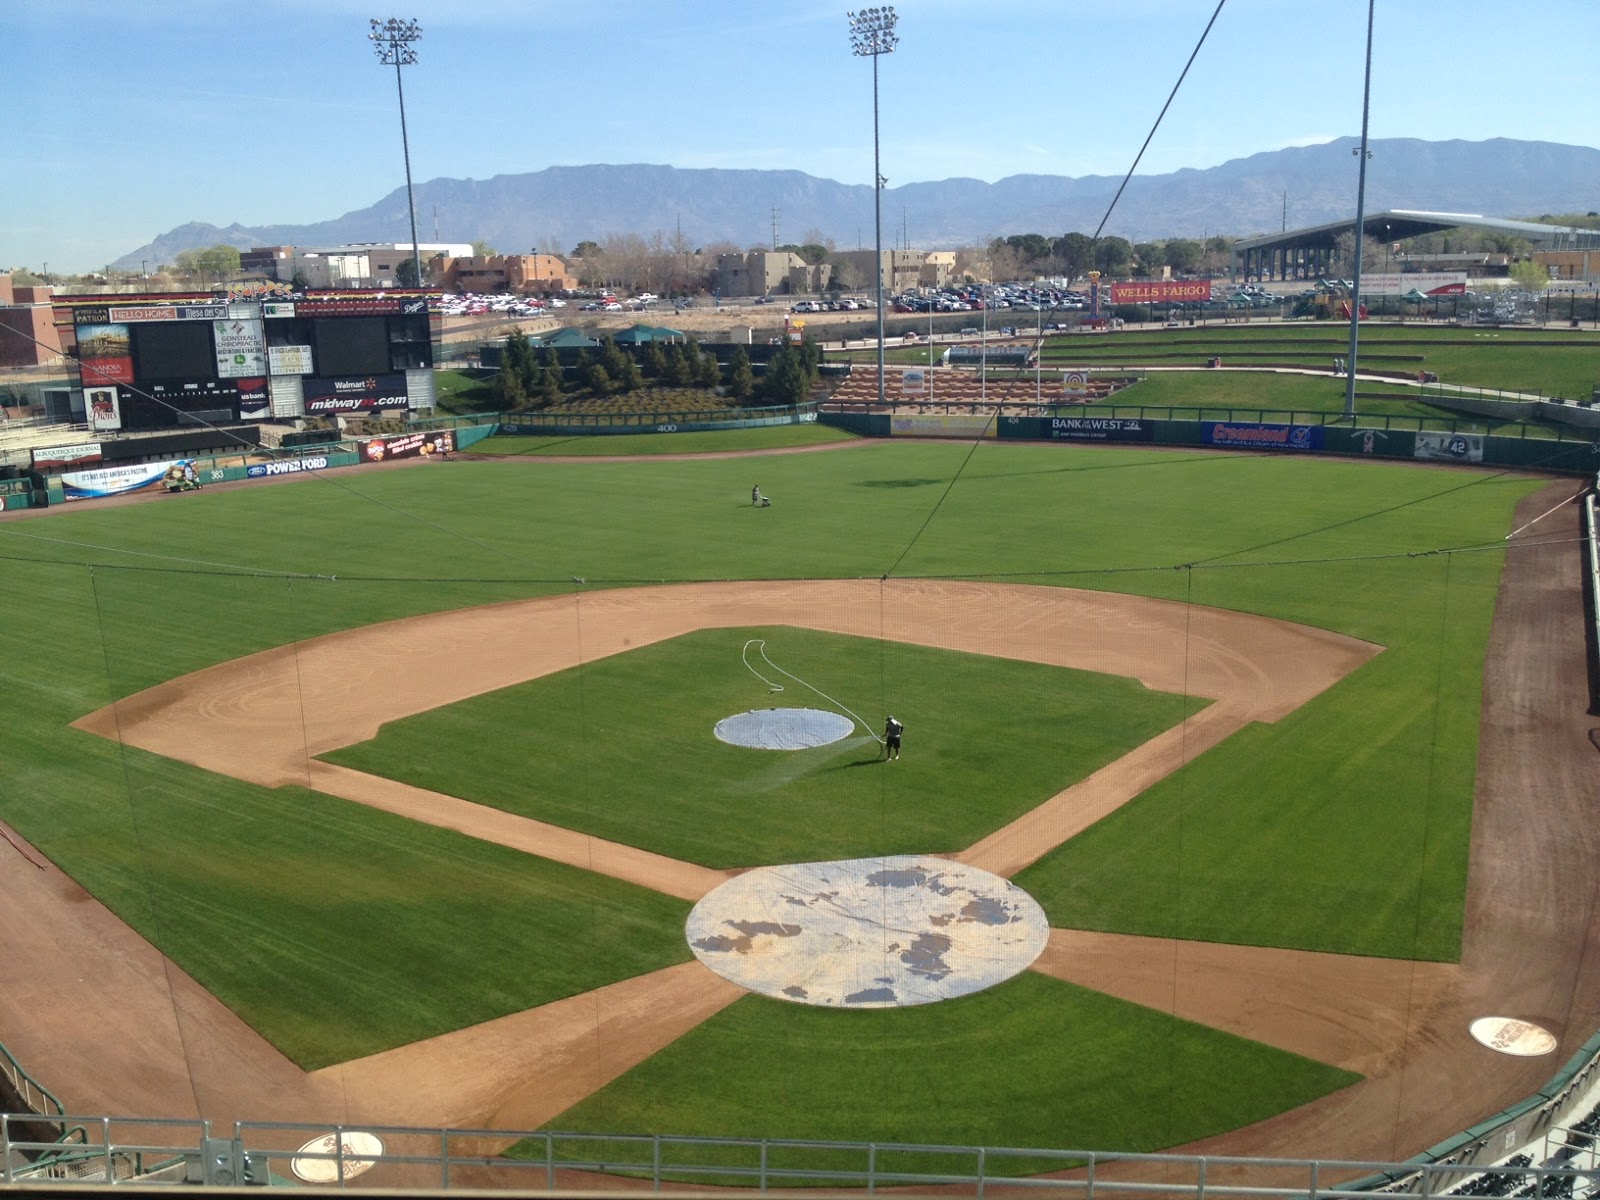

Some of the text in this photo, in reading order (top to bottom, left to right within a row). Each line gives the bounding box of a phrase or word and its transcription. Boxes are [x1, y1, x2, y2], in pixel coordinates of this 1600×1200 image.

[1115, 285, 1206, 298] WELLS FARGO
[114, 309, 143, 319] HELLO
[147, 308, 173, 319] HOME
[185, 308, 203, 319] Mesa
[204, 308, 214, 318] del
[334, 380, 365, 389] Walmart
[1008, 416, 1020, 425] 404
[1052, 419, 1082, 429] BANK
[1091, 420, 1124, 430] WEST
[657, 424, 677, 433] 400
[1212, 423, 1289, 443] Creamland
[386, 438, 410, 449] chocolate
[405, 441, 423, 450] cookies
[1450, 441, 1465, 453] 42
[35, 448, 75, 457] ALBUQUERQUE
[266, 460, 301, 475] POWER
[301, 457, 327, 470] FORD
[109, 469, 131, 478] AMERICA'S
[131, 467, 148, 475] PASTIME
[211, 469, 225, 480] 383
